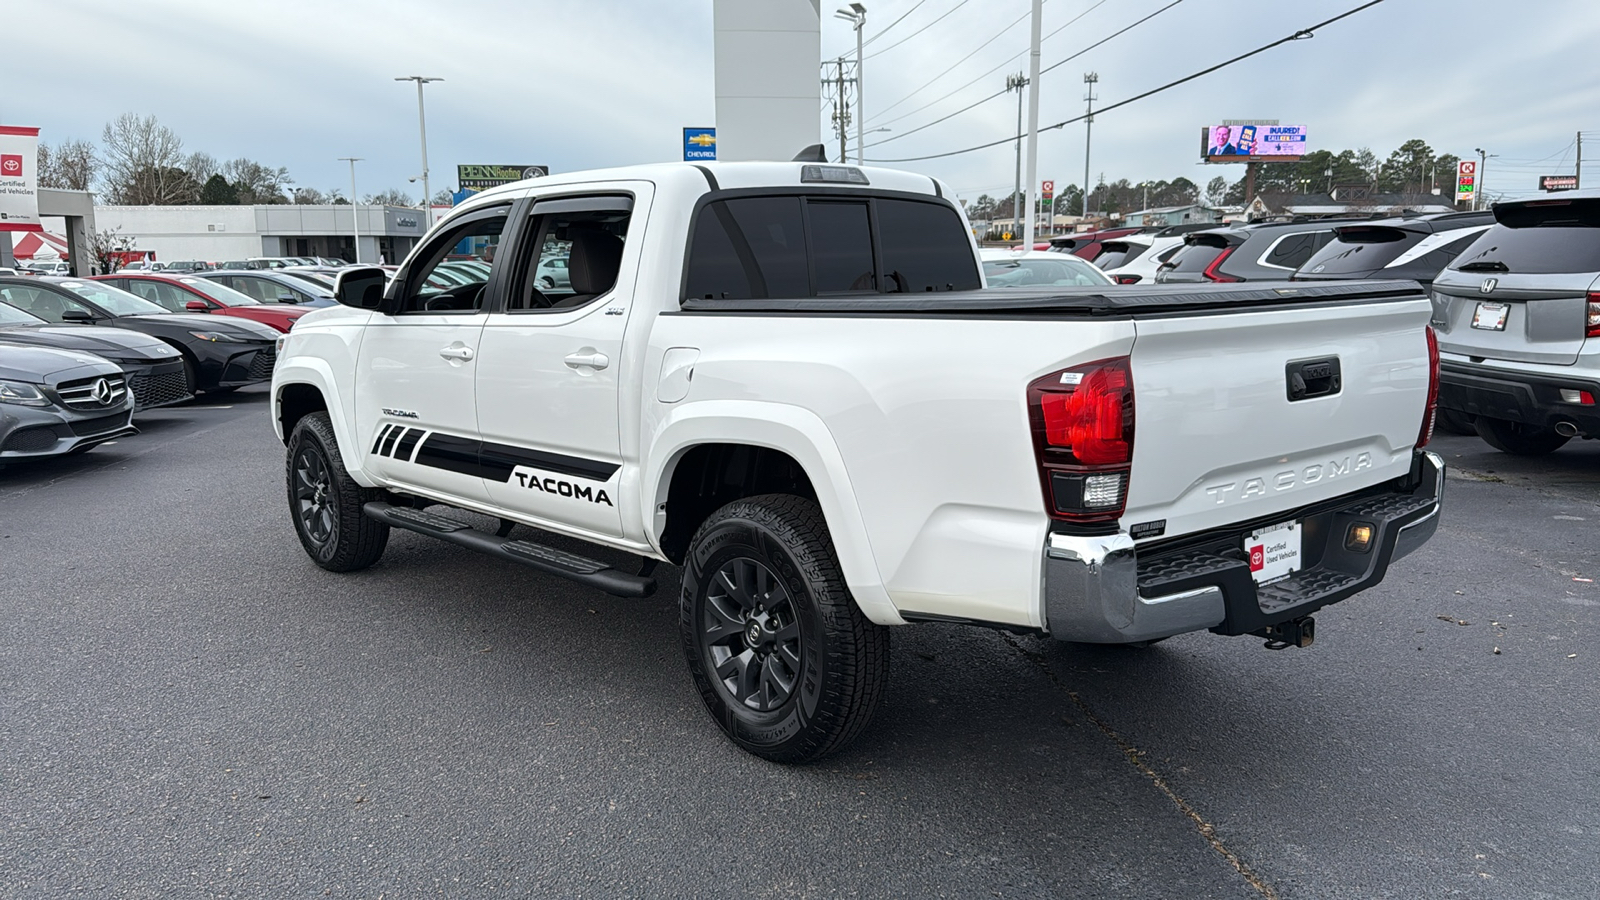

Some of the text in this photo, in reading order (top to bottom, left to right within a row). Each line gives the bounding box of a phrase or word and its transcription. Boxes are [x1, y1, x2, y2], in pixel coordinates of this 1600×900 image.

[461, 166, 497, 177] PENN
[496, 167, 522, 180] Roofing
[1307, 365, 1332, 378] TOYOTA
[381, 408, 420, 419] TACOMA
[1206, 451, 1373, 505] TACOMA
[514, 471, 614, 507] TACOMA
[1266, 541, 1287, 554] Certified
[1266, 549, 1297, 564] Used Vehicles
